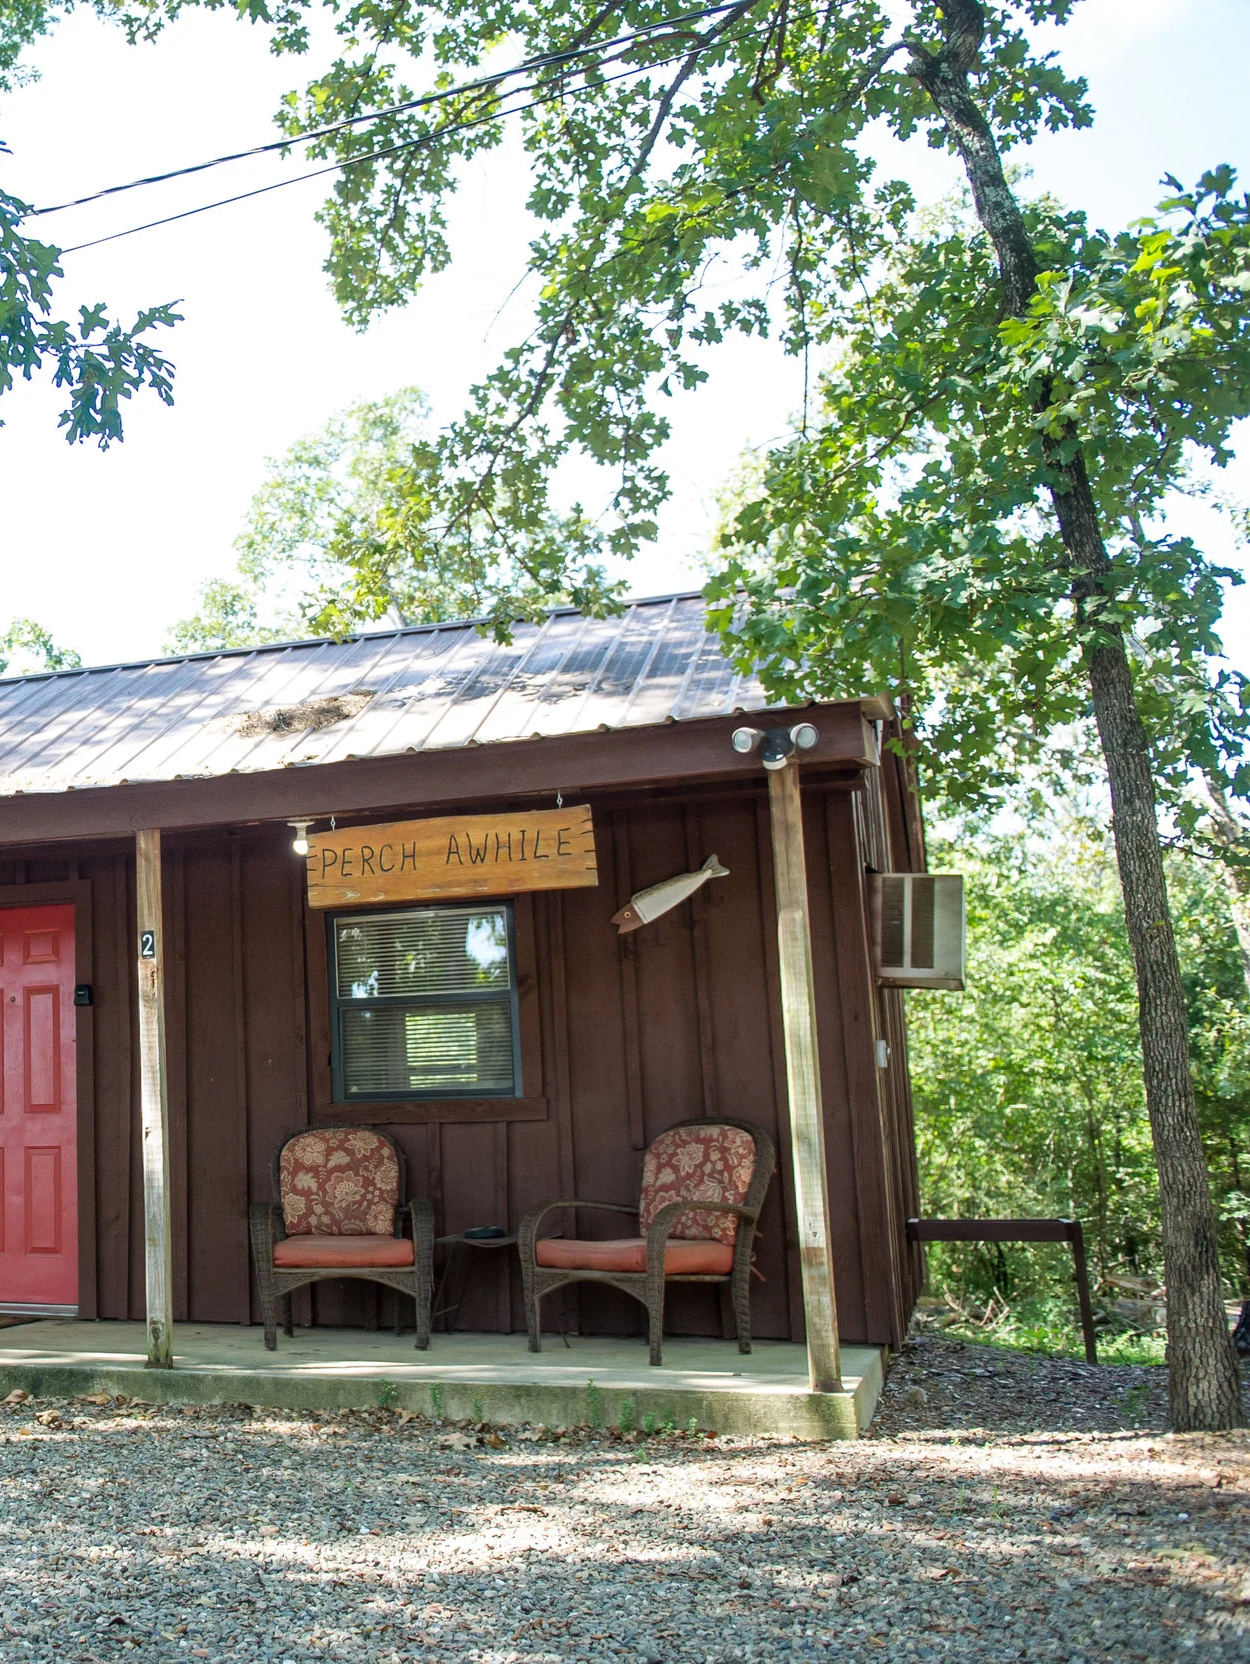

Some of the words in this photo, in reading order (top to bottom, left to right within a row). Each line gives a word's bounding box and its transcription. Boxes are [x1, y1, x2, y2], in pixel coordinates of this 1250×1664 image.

[321, 841, 418, 879] PERCH
[445, 827, 573, 866] AWHILE
[142, 934, 154, 956] 2
